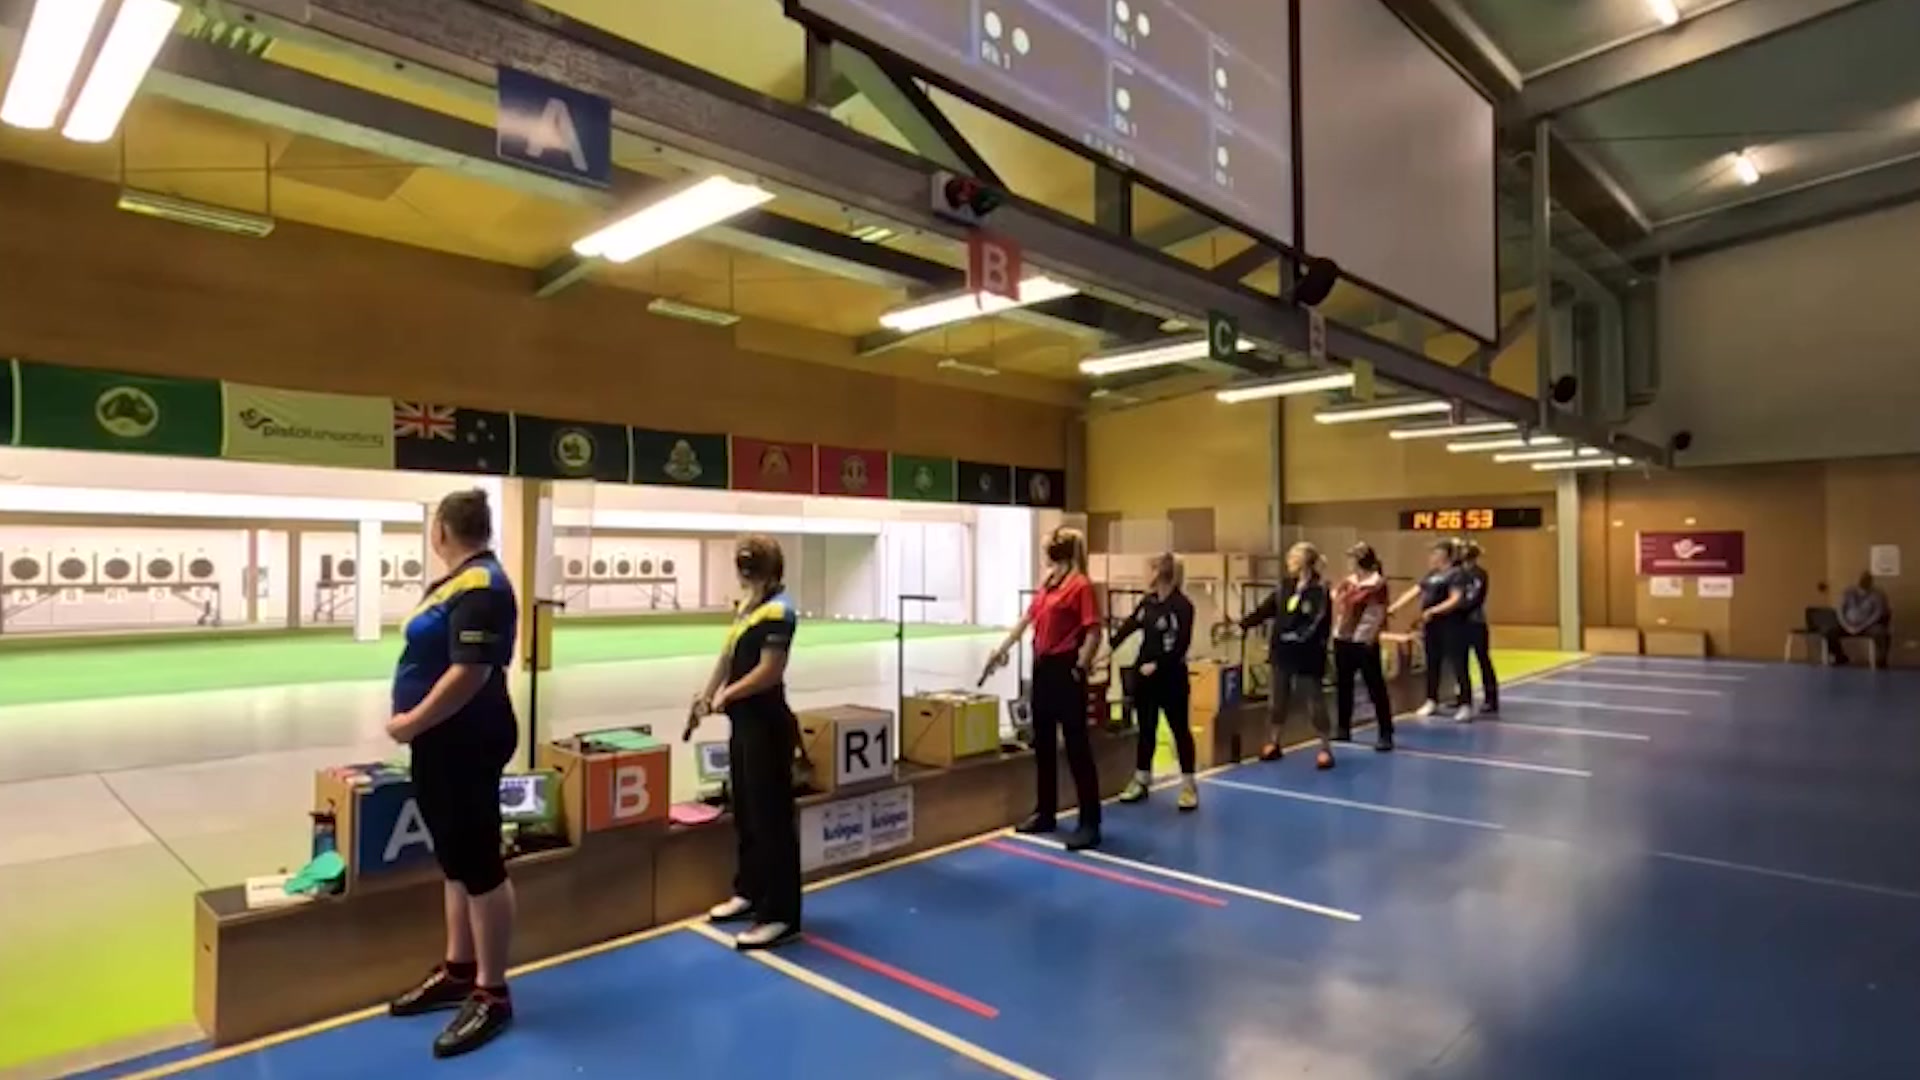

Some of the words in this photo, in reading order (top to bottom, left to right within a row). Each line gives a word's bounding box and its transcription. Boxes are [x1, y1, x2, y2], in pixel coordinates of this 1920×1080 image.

[525, 97, 588, 172] A
[982, 243, 1009, 292] B
[1214, 319, 1232, 355] C
[1413, 511, 1433, 529] 14
[1436, 511, 1462, 529] 26
[1465, 509, 1494, 529] 53
[845, 724, 889, 774] R1
[613, 764, 650, 819] B
[382, 798, 435, 862] A
